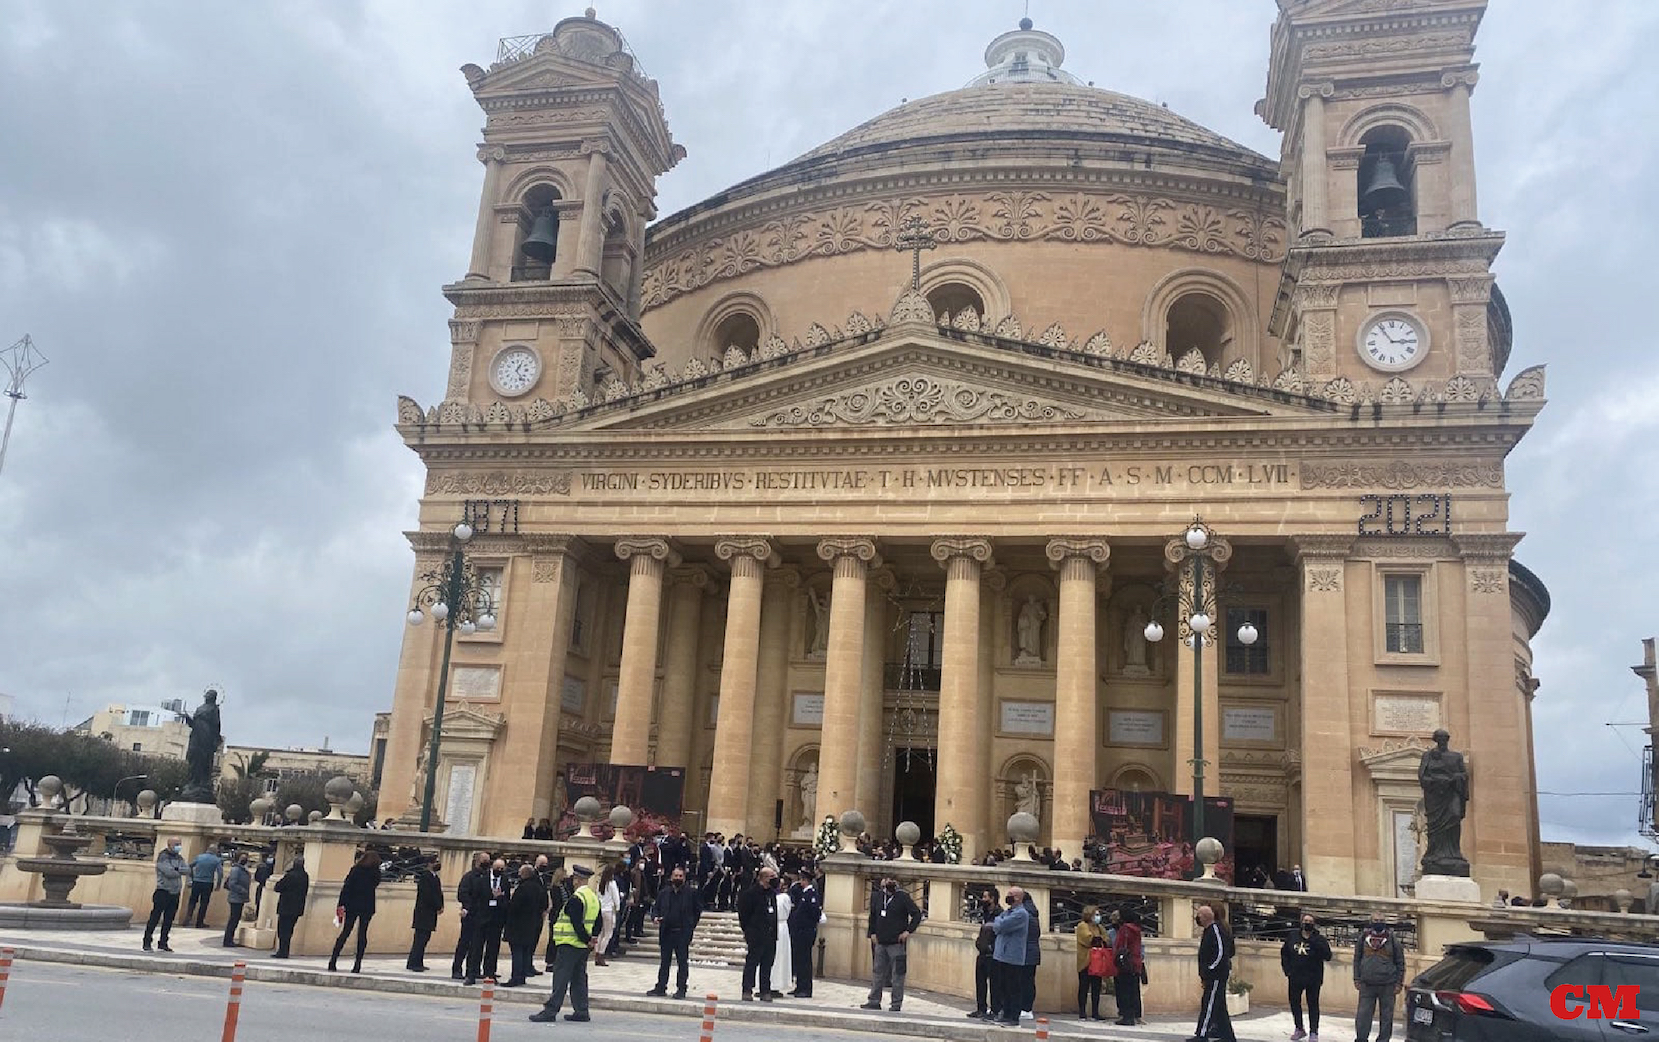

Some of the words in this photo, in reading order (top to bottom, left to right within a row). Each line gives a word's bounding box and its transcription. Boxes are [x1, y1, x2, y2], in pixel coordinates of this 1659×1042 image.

[580, 473, 638, 491] VIRGINI
[649, 472, 744, 490] SYDERIBVS
[754, 471, 866, 490] RESTITVTAE
[878, 470, 892, 488] T
[902, 470, 916, 488] H
[927, 468, 1046, 488] MVSTENSES
[1058, 468, 1086, 487] FF
[1099, 468, 1114, 486] A
[1126, 467, 1141, 485] S
[1359, 493, 1450, 535] 2021
